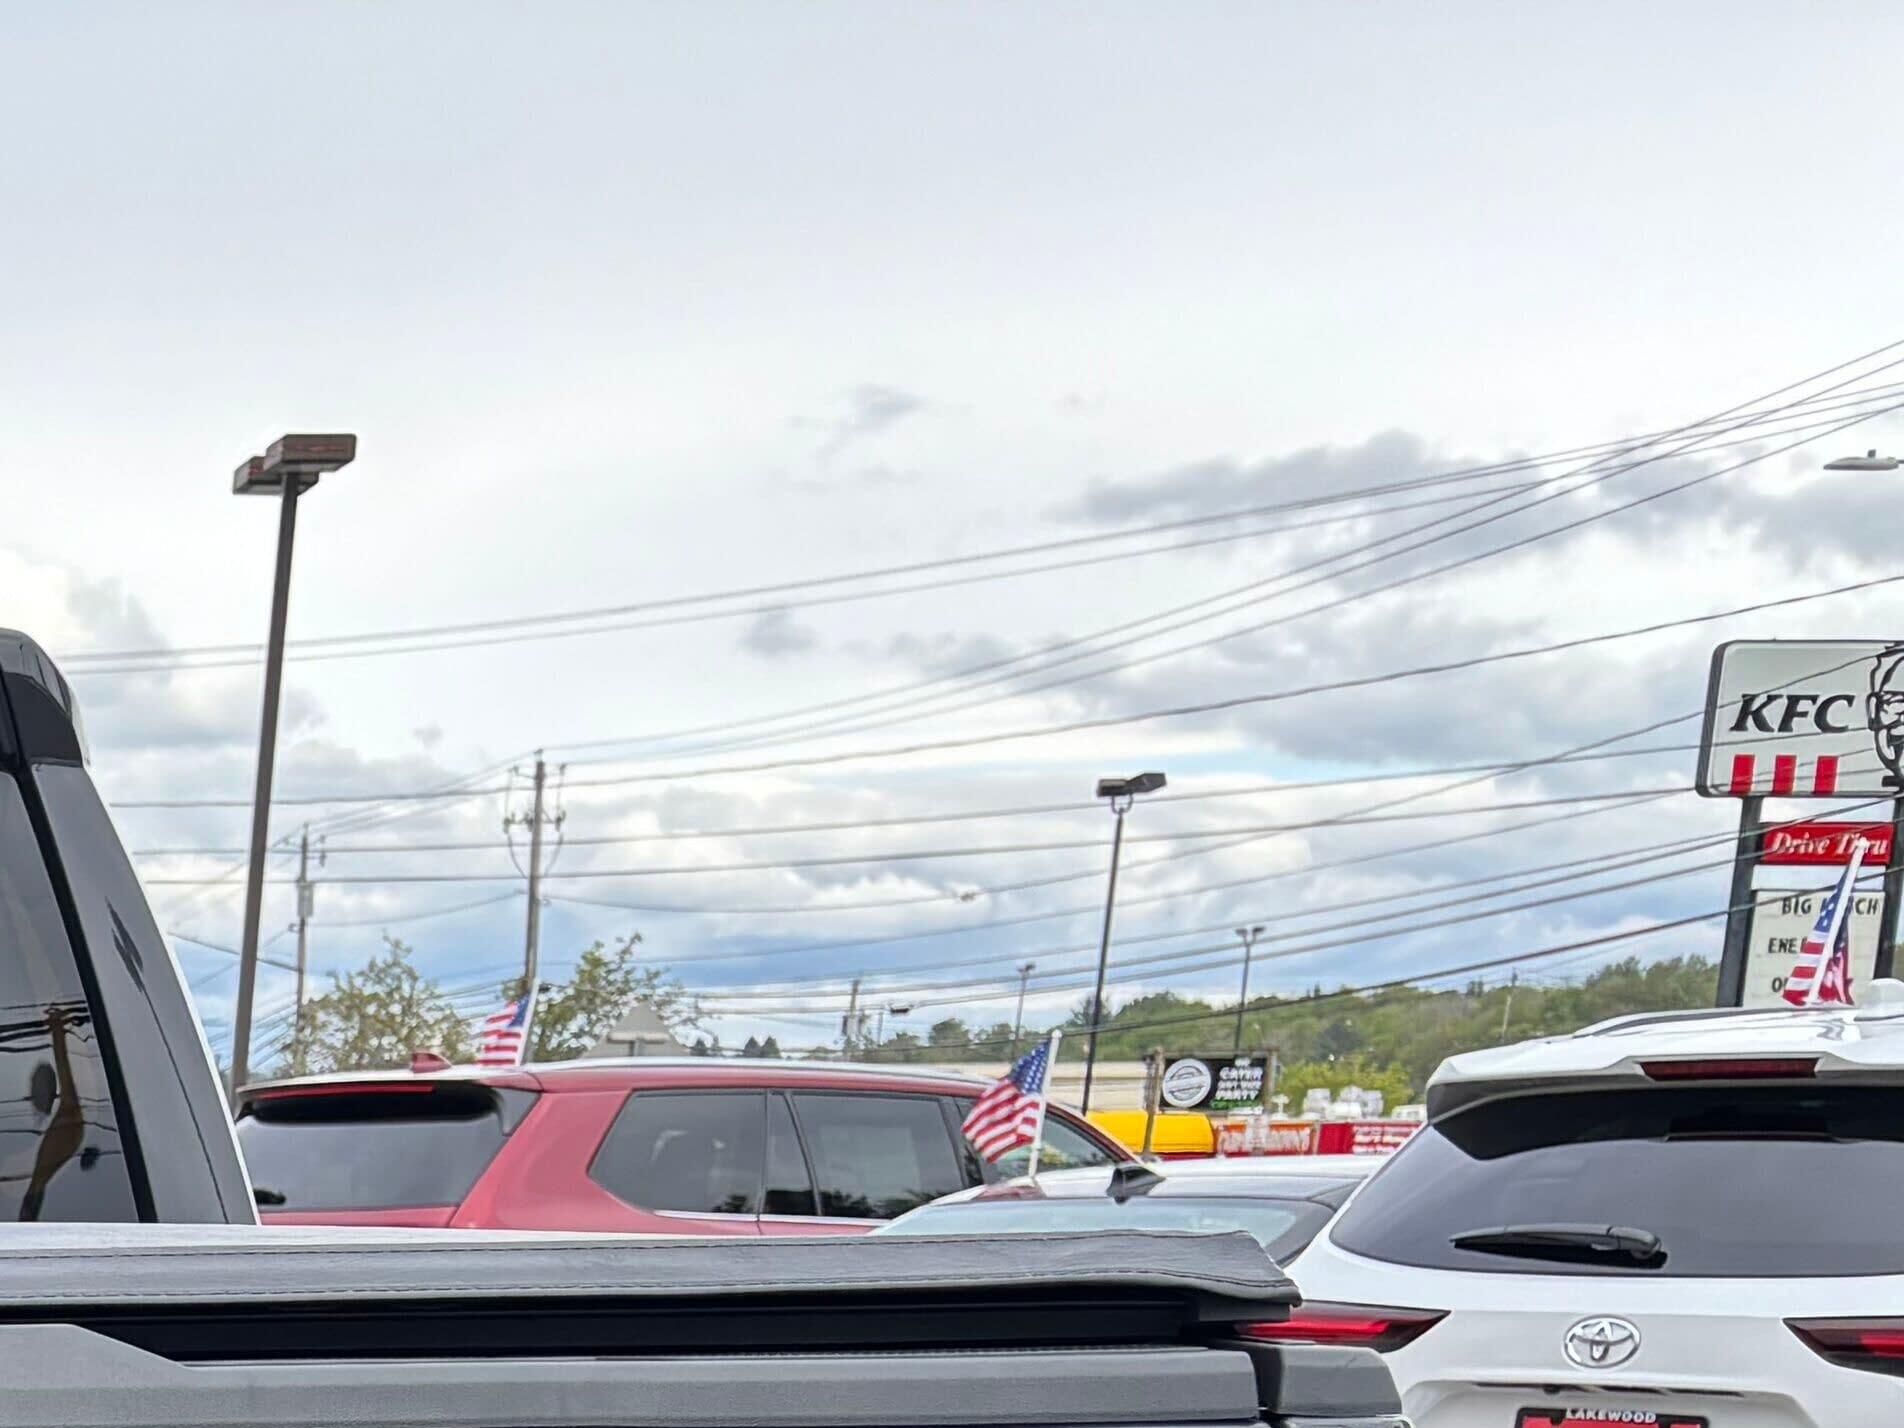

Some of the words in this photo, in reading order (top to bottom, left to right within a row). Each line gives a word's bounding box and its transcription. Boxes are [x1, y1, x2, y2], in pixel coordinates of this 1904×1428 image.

[1729, 693, 1856, 733] KFC
[1772, 831, 1830, 855] Drive
[1782, 897, 1812, 915] BIG
[1566, 1408, 1657, 1424] LAKEWOOD
